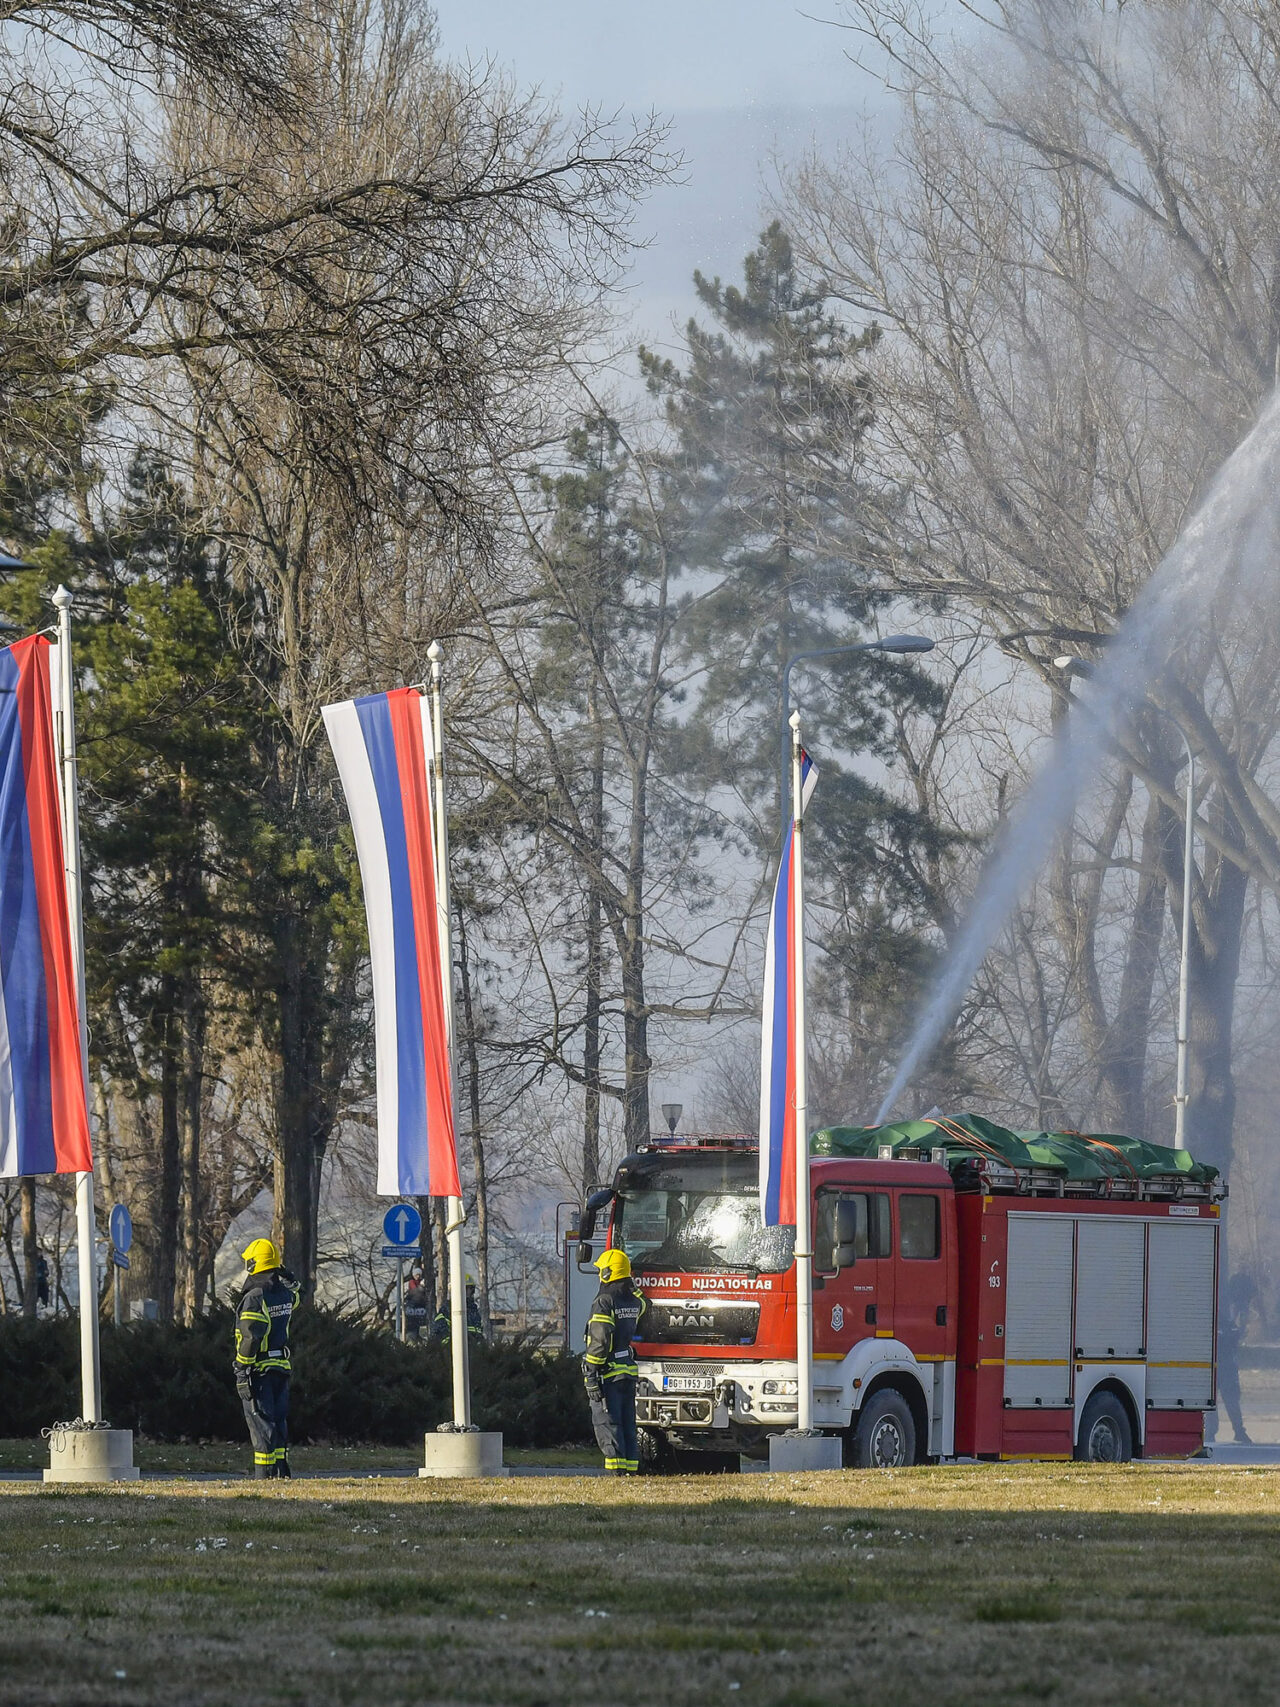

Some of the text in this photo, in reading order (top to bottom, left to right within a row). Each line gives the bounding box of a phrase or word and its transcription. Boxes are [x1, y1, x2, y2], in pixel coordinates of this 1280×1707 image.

[988, 1276, 1001, 1288] 193
[669, 1315, 715, 1327] MAN
[668, 1379, 678, 1388] BG
